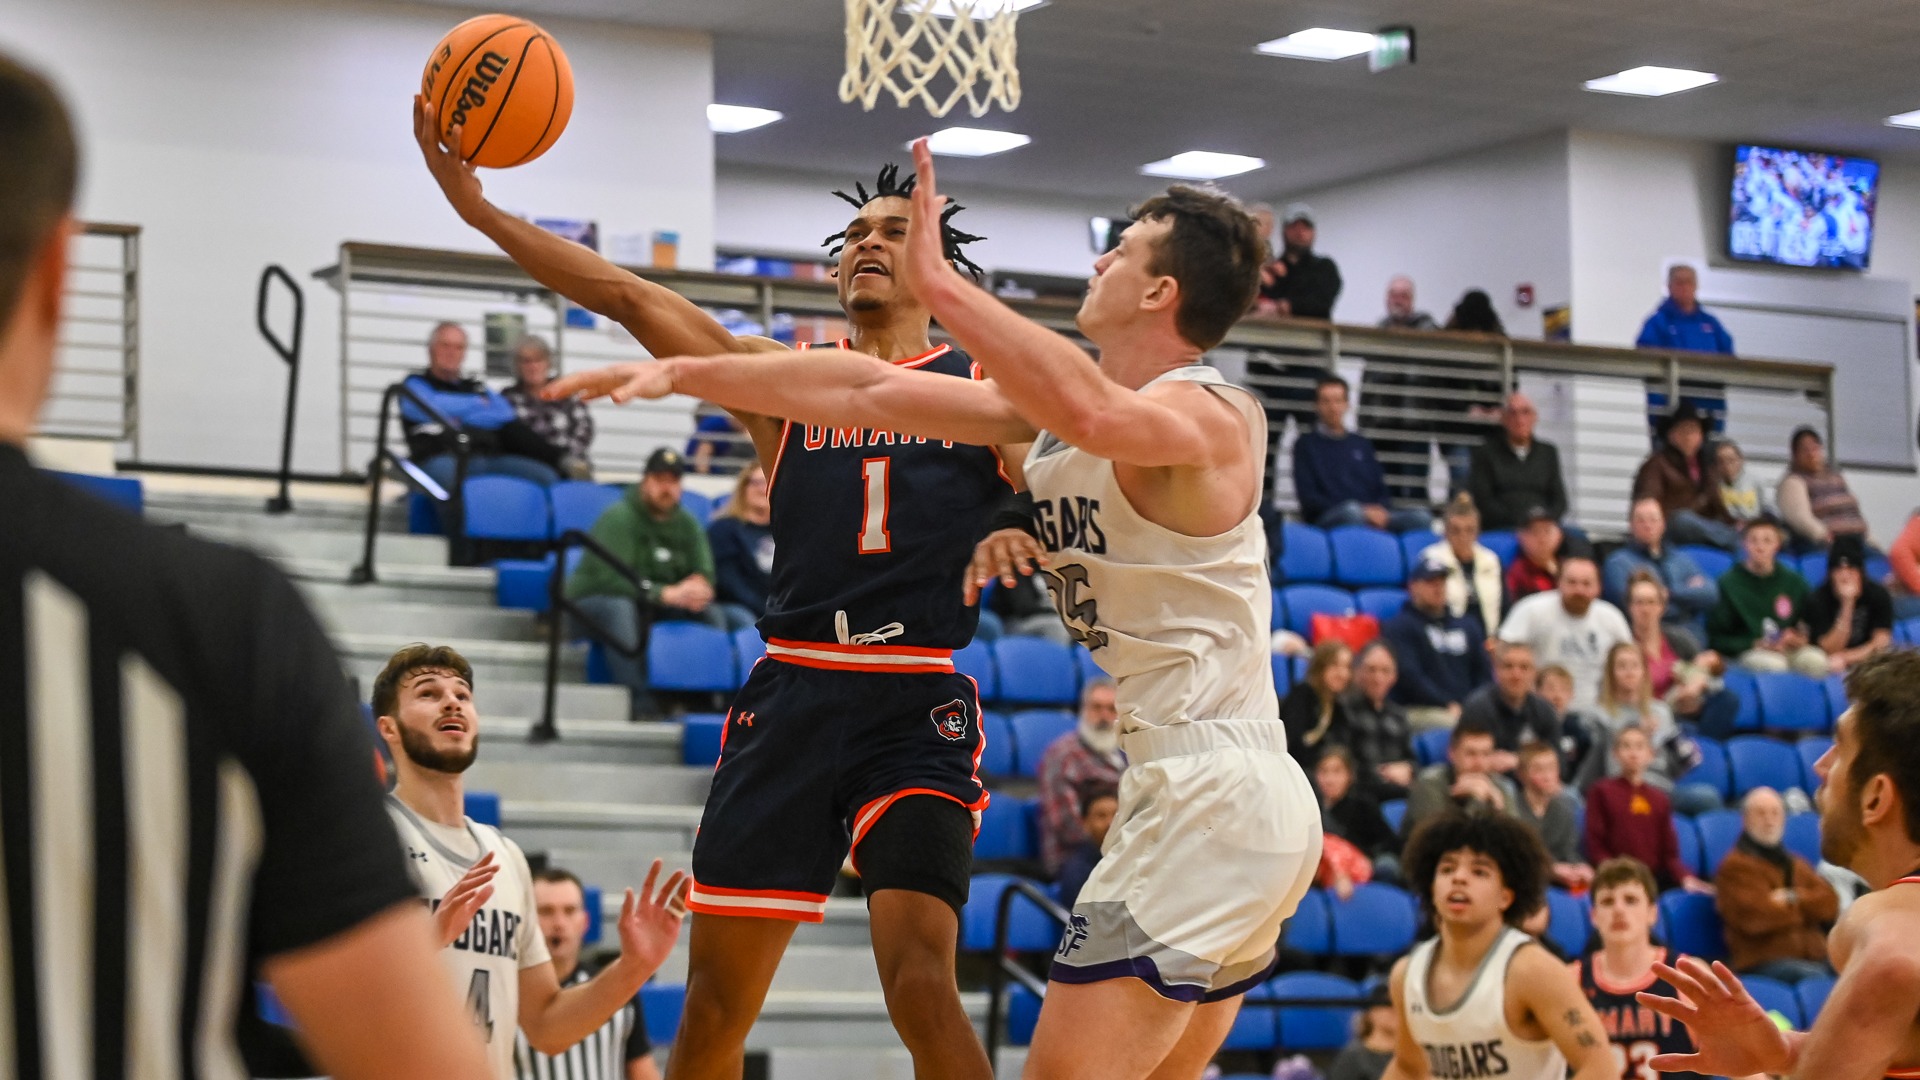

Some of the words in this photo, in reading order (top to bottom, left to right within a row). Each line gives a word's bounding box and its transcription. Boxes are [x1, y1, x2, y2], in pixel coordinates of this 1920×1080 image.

[857, 456, 891, 555] 1
[1033, 496, 1107, 555] GARS
[465, 968, 495, 1044] 4
[1600, 1004, 1672, 1038] MARY
